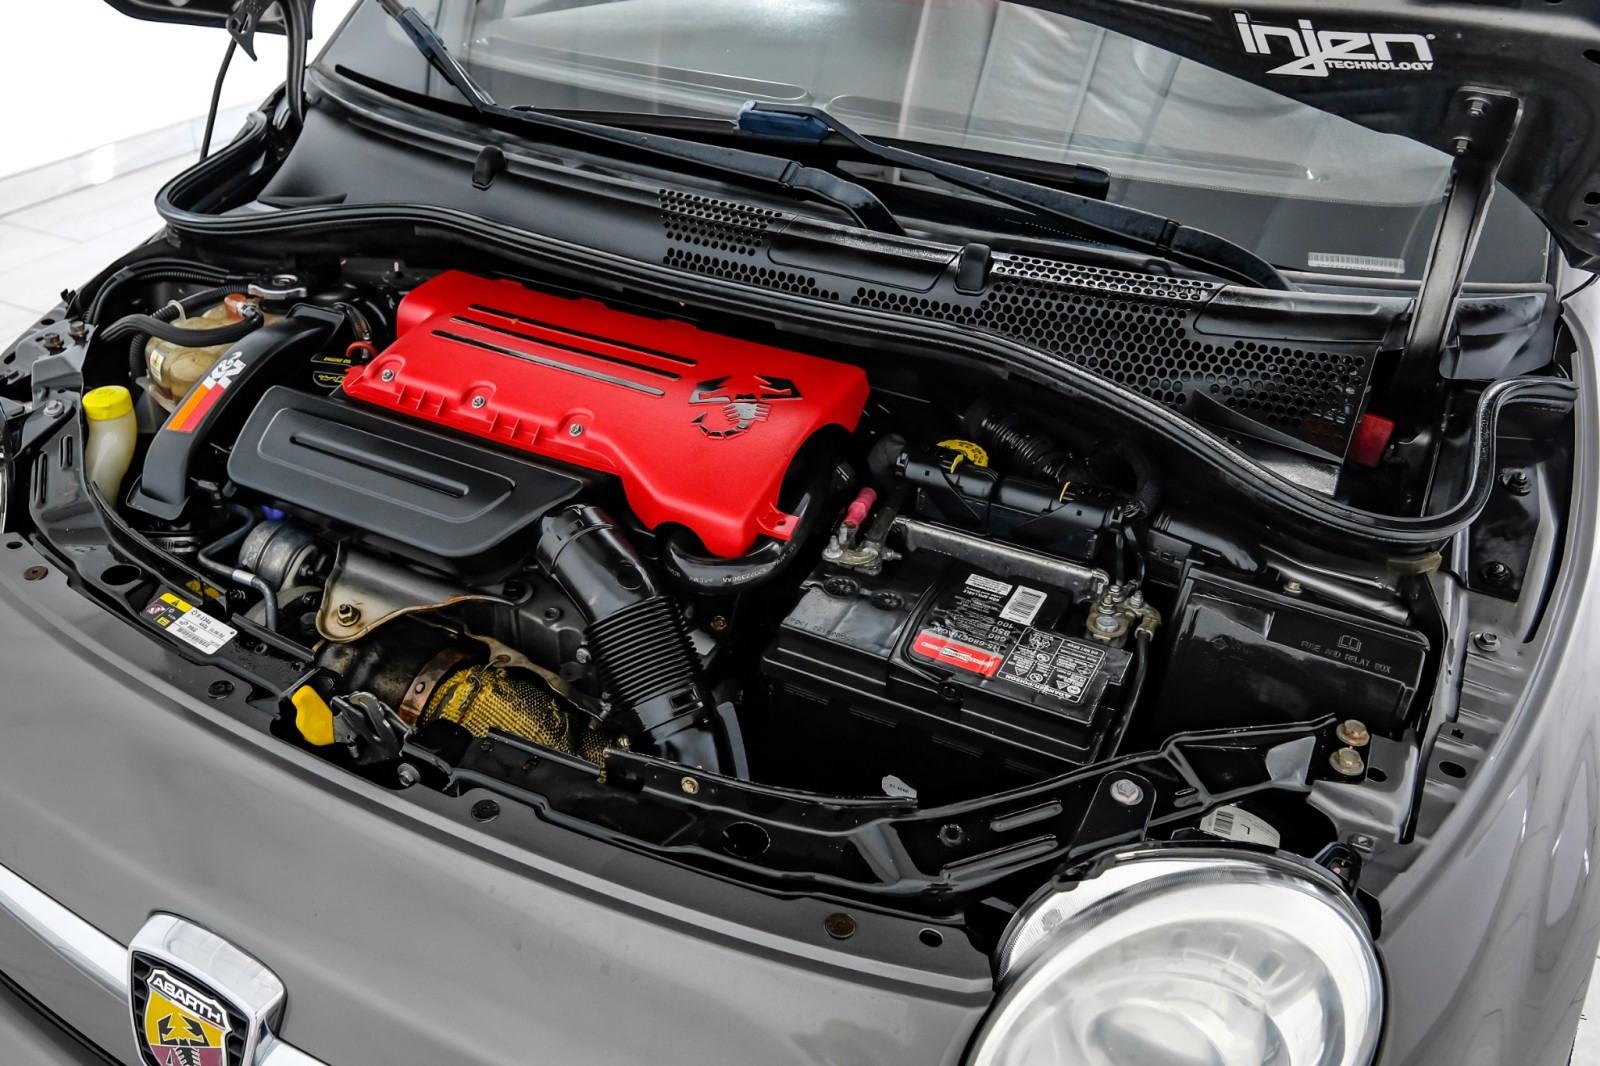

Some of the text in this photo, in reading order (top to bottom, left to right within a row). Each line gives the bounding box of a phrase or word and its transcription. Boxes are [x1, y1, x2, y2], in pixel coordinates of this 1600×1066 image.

[1325, 59, 1433, 71] TECHNOLOGY
[997, 620, 1014, 630] 100
[991, 626, 1011, 637] 850
[988, 633, 1007, 643] 680
[1301, 640, 1392, 674] FUSE AND RELAY BOX
[152, 976, 222, 1024] ABARTH
